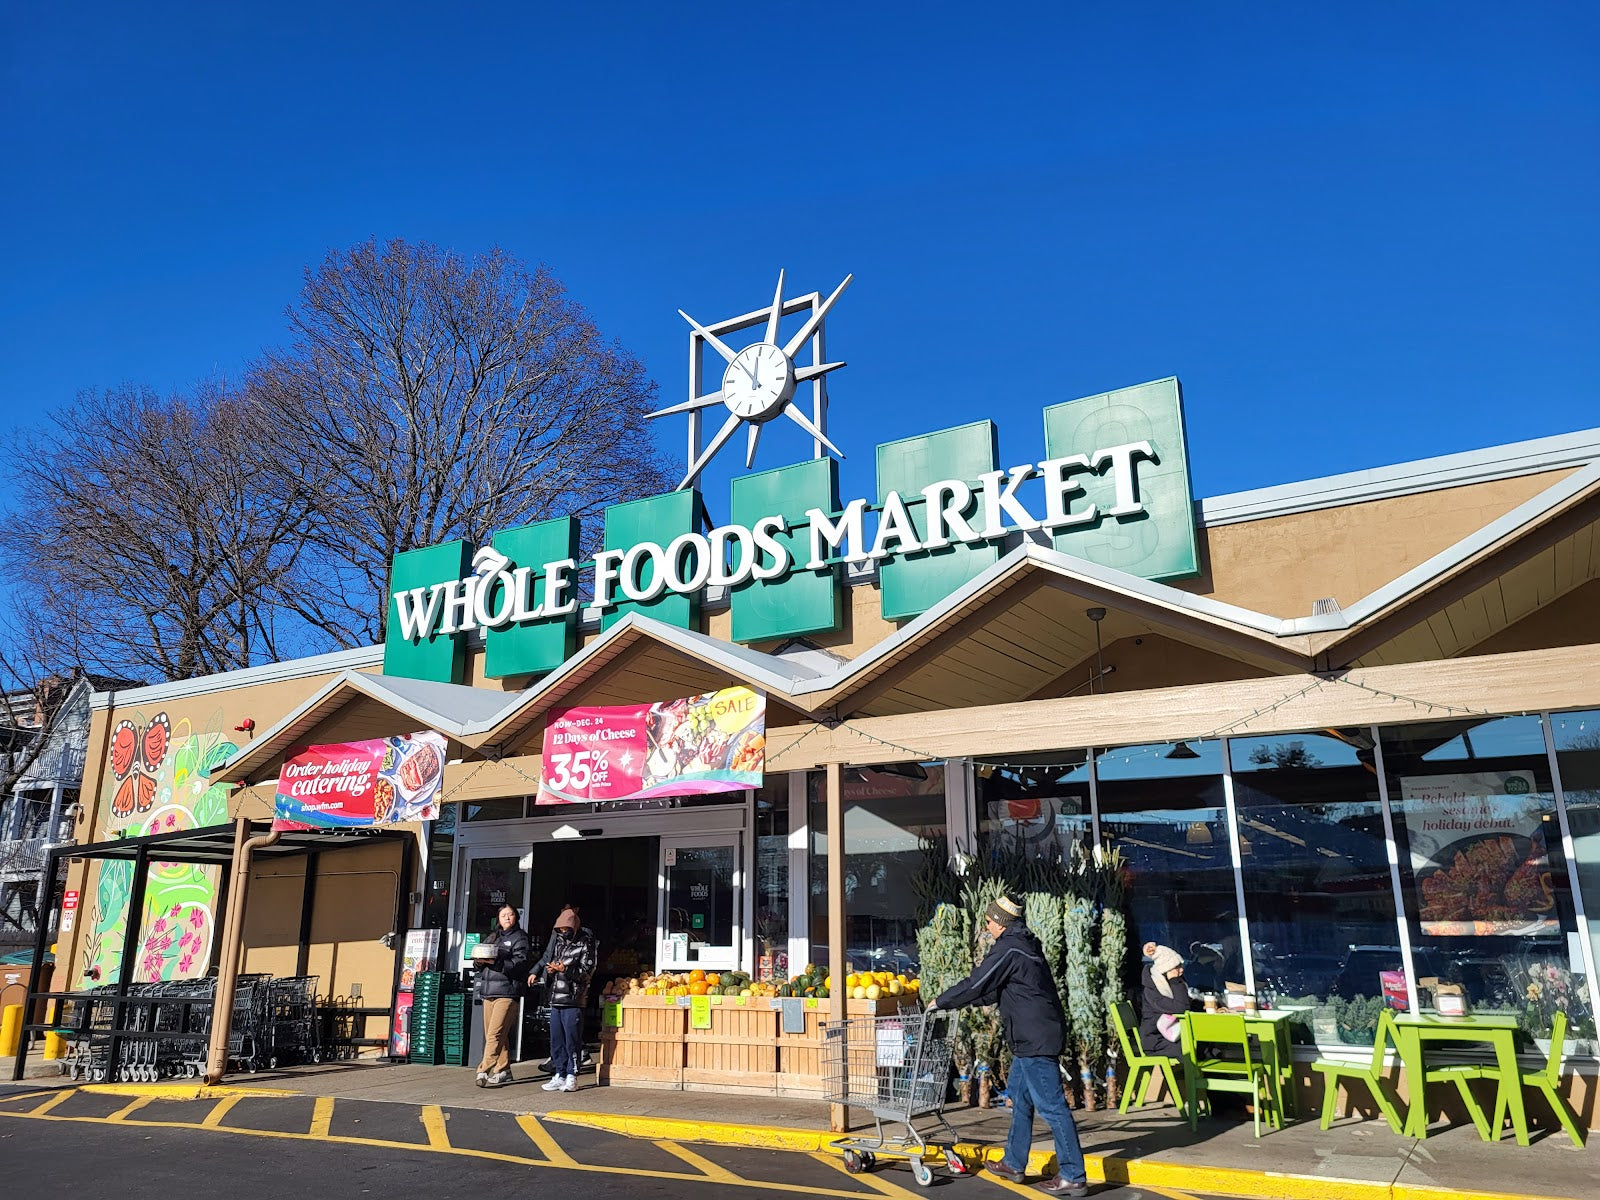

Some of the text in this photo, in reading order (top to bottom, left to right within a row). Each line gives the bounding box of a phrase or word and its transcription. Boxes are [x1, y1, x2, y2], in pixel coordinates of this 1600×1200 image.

[394, 440, 1159, 642] WHOLE FOODS MARKET
[714, 698, 755, 716] SALE
[594, 717, 604, 725] 24
[552, 728, 636, 745] 12 Days of Cheese
[286, 758, 371, 778] Order holiday
[291, 773, 372, 796] catering.
[591, 771, 608, 783] OFF
[300, 801, 343, 813] shop.wfm.com
[1423, 819, 1472, 832] holiday
[1474, 818, 1515, 830] debut.
